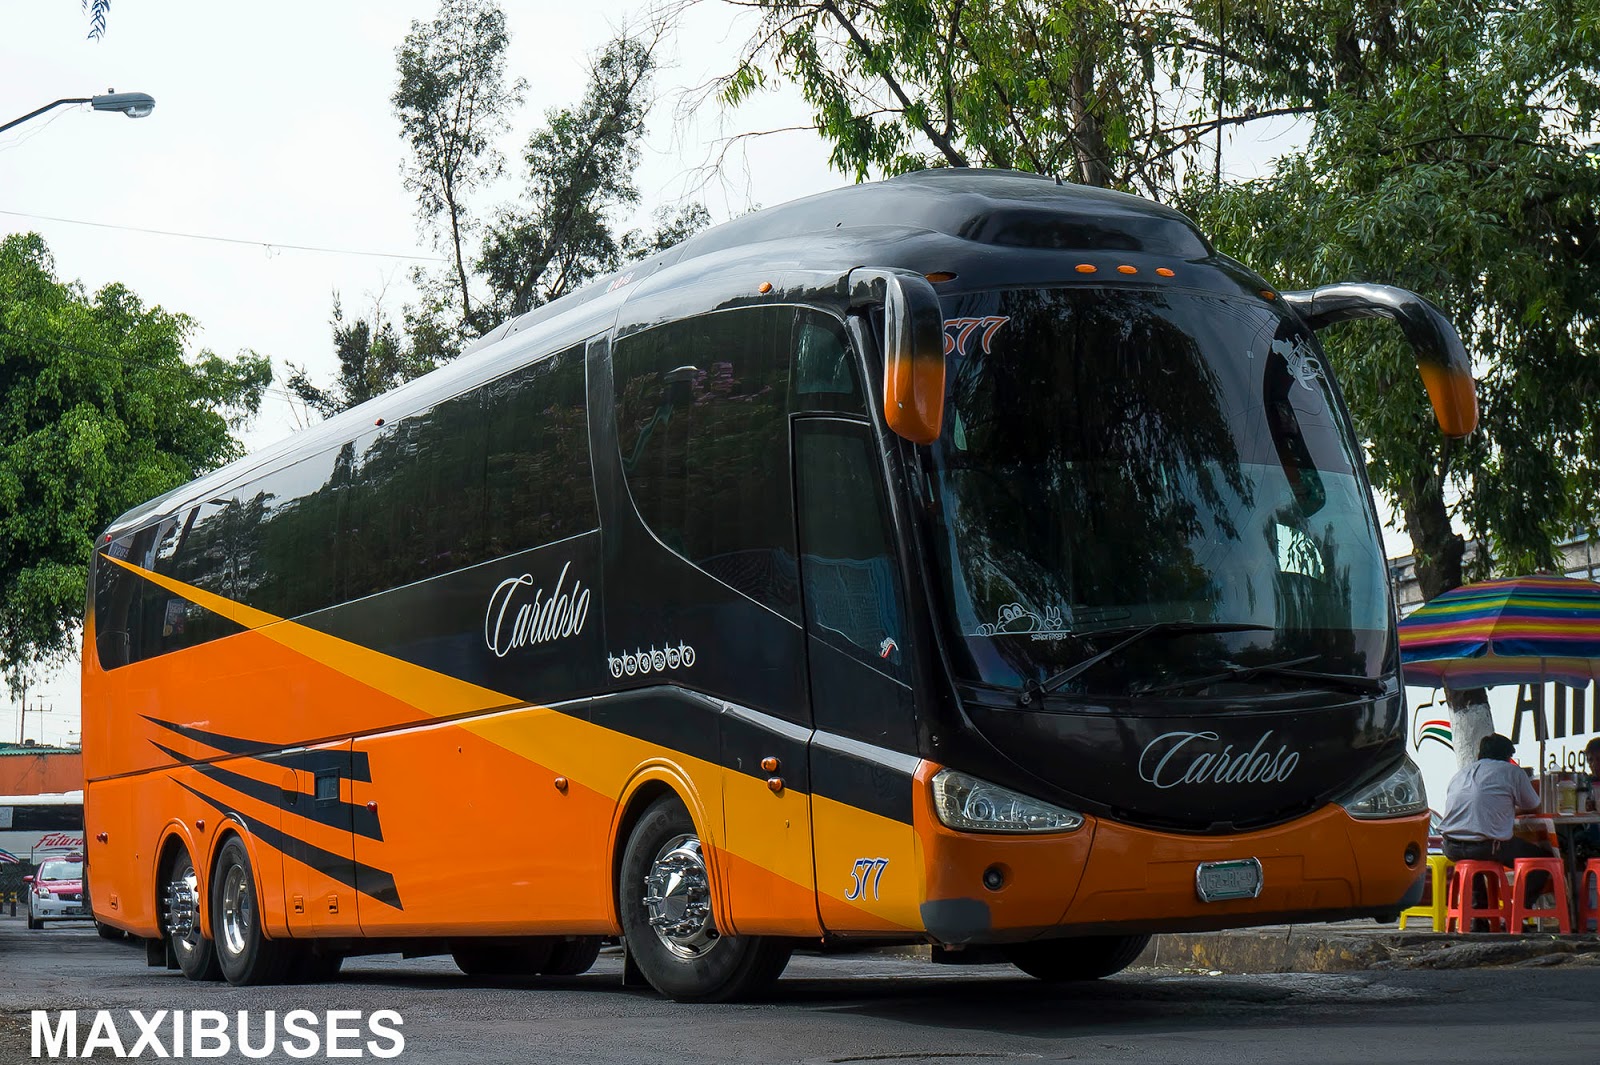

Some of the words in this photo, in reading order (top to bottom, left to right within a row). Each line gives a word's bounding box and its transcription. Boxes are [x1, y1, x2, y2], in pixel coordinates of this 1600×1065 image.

[944, 316, 1010, 355] 577
[485, 560, 590, 657] Cardoso
[1138, 730, 1300, 789] Cardoso
[844, 857, 889, 901] 577
